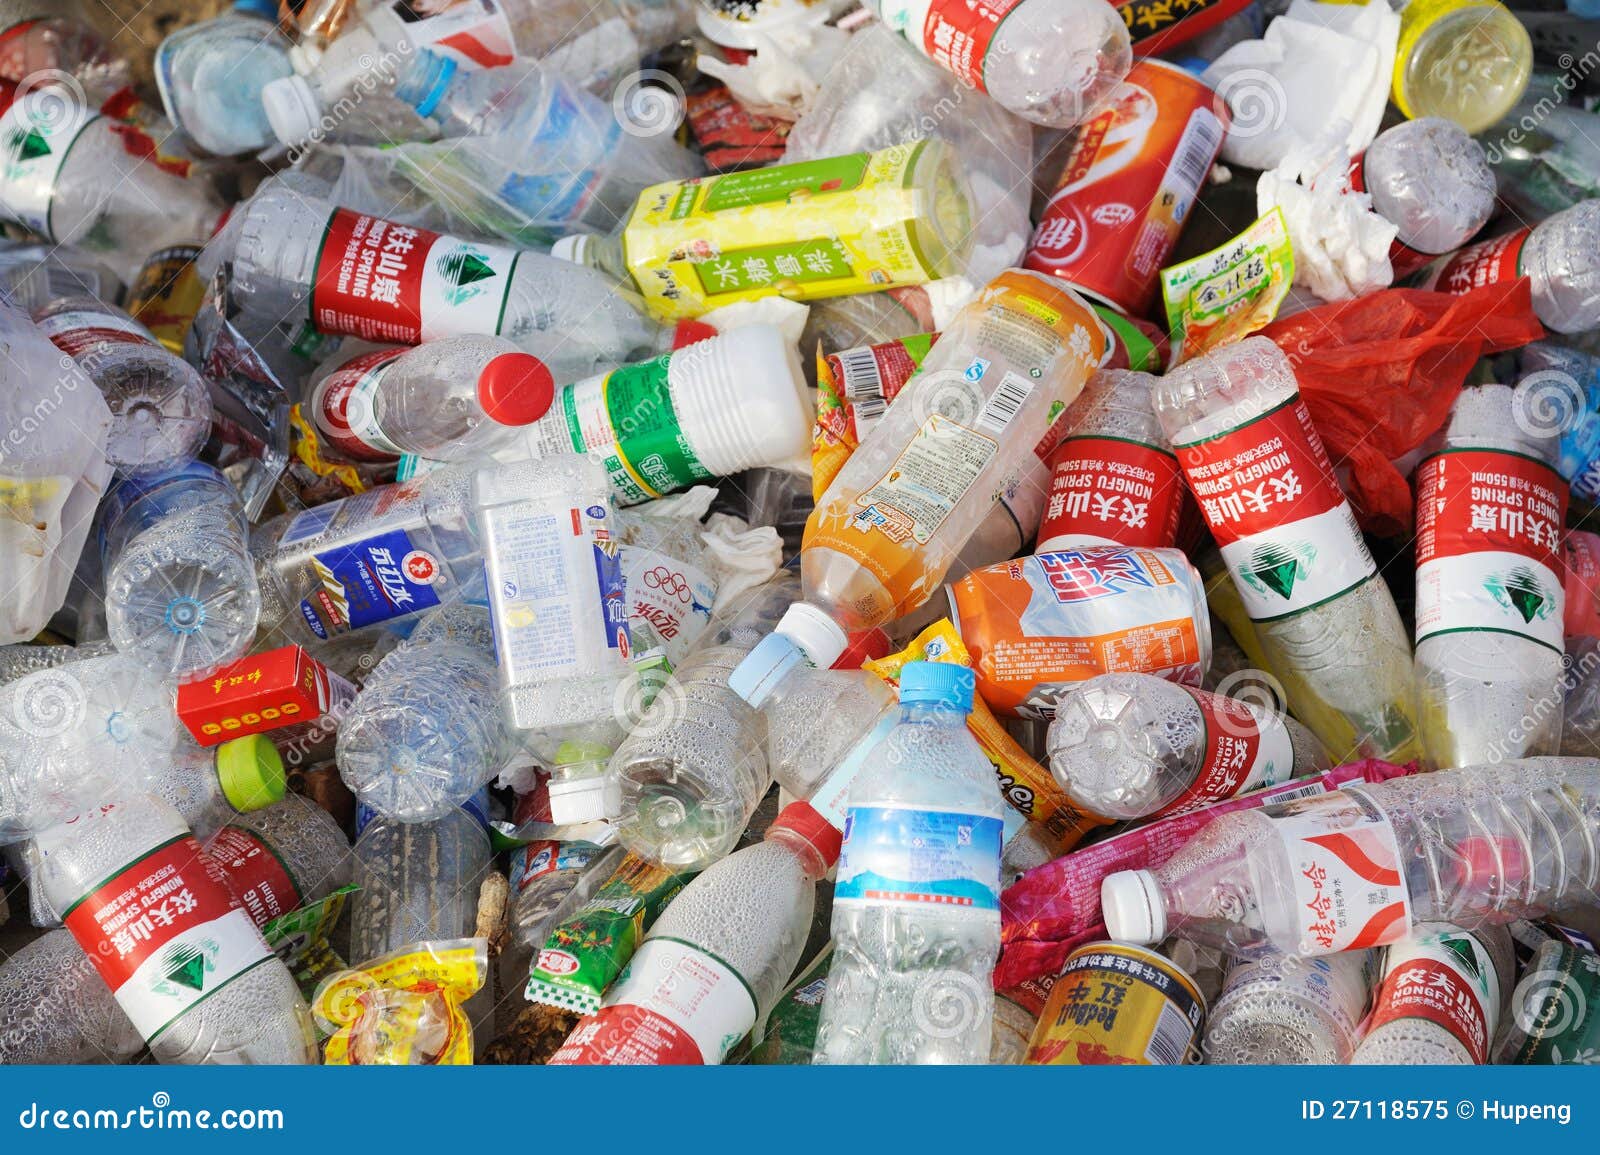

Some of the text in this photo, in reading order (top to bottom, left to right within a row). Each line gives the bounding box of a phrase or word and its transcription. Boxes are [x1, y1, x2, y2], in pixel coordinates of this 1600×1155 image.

[1032, 217, 1077, 250] 银
[352, 248, 376, 298] SPRING
[712, 247, 833, 288] 冰糖雪梨
[1107, 462, 1155, 483] 饮用天然水
[1233, 437, 1283, 467] 饮用天然水
[1052, 474, 1153, 501] NONGFU SPRING
[1193, 451, 1291, 497] NONGFU SPRING
[1048, 490, 1149, 528] 农夫山泉
[1201, 468, 1303, 527] 农夫山泉
[1471, 486, 1524, 508] SPRING
[1470, 504, 1560, 554] 农夫山泉
[367, 546, 416, 606] 苏打水
[1206, 737, 1234, 792] NONGFU
[101, 874, 185, 936] NONGFU SPRING
[257, 880, 281, 916] 550ml
[1302, 861, 1336, 948] 娃哈哈
[1332, 877, 1348, 929] 饮用纯净水
[110, 887, 198, 957] 农夫山泉
[1067, 981, 1127, 1007] 红牛
[1391, 996, 1446, 1013] 饮用天然水
[1392, 985, 1454, 1007] NONGFU
[1396, 968, 1485, 1048] 农夫山泉
[1056, 1002, 1119, 1032] RedBull
